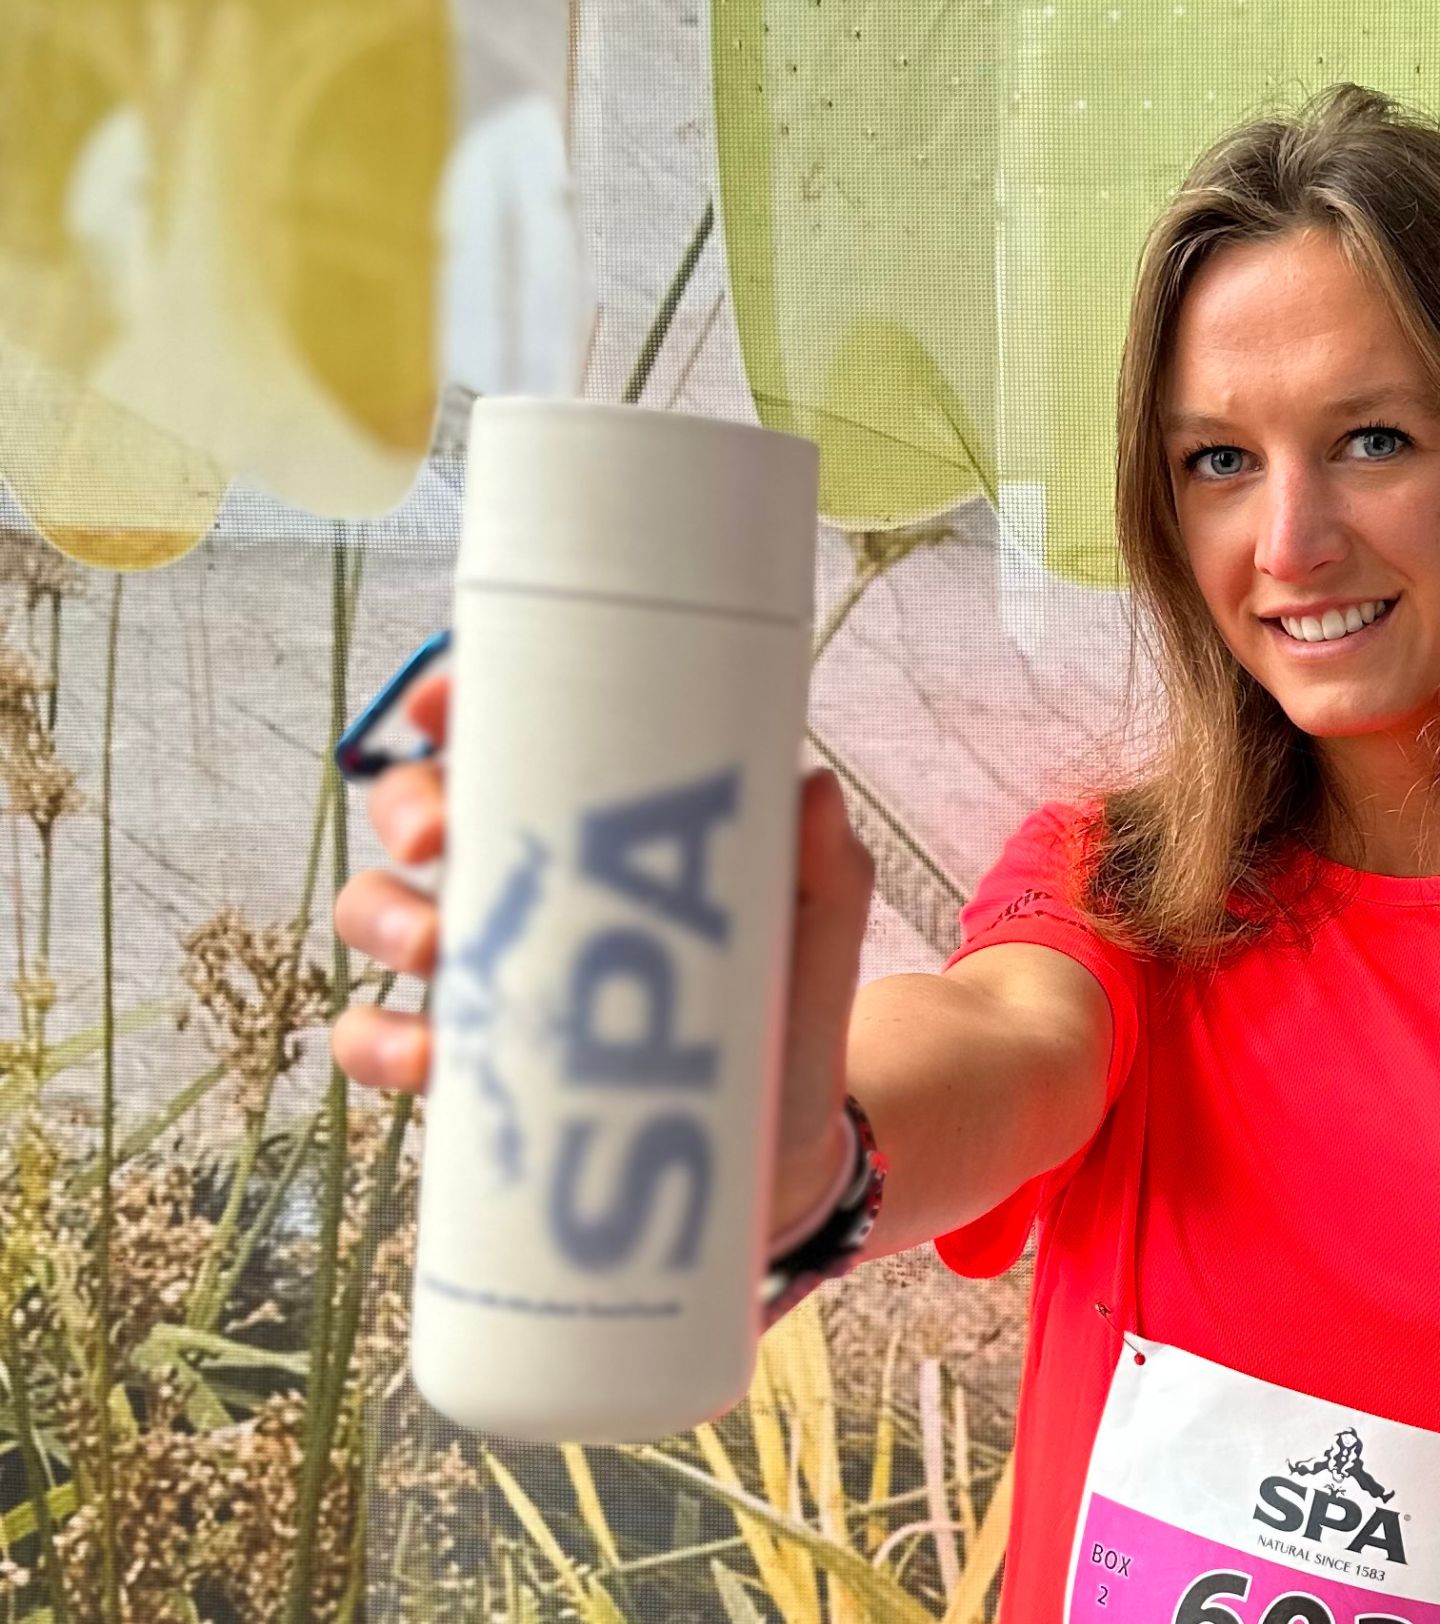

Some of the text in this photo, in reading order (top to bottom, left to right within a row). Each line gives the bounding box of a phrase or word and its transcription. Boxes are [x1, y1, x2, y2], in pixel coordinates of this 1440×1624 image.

[549, 768, 743, 1275] SPA
[1252, 1475, 1409, 1566] SPA
[1092, 1543, 1132, 1577] BOX
[1257, 1534, 1386, 1582] NATURAL SINCE 1583
[1097, 1585, 1109, 1606] 2
